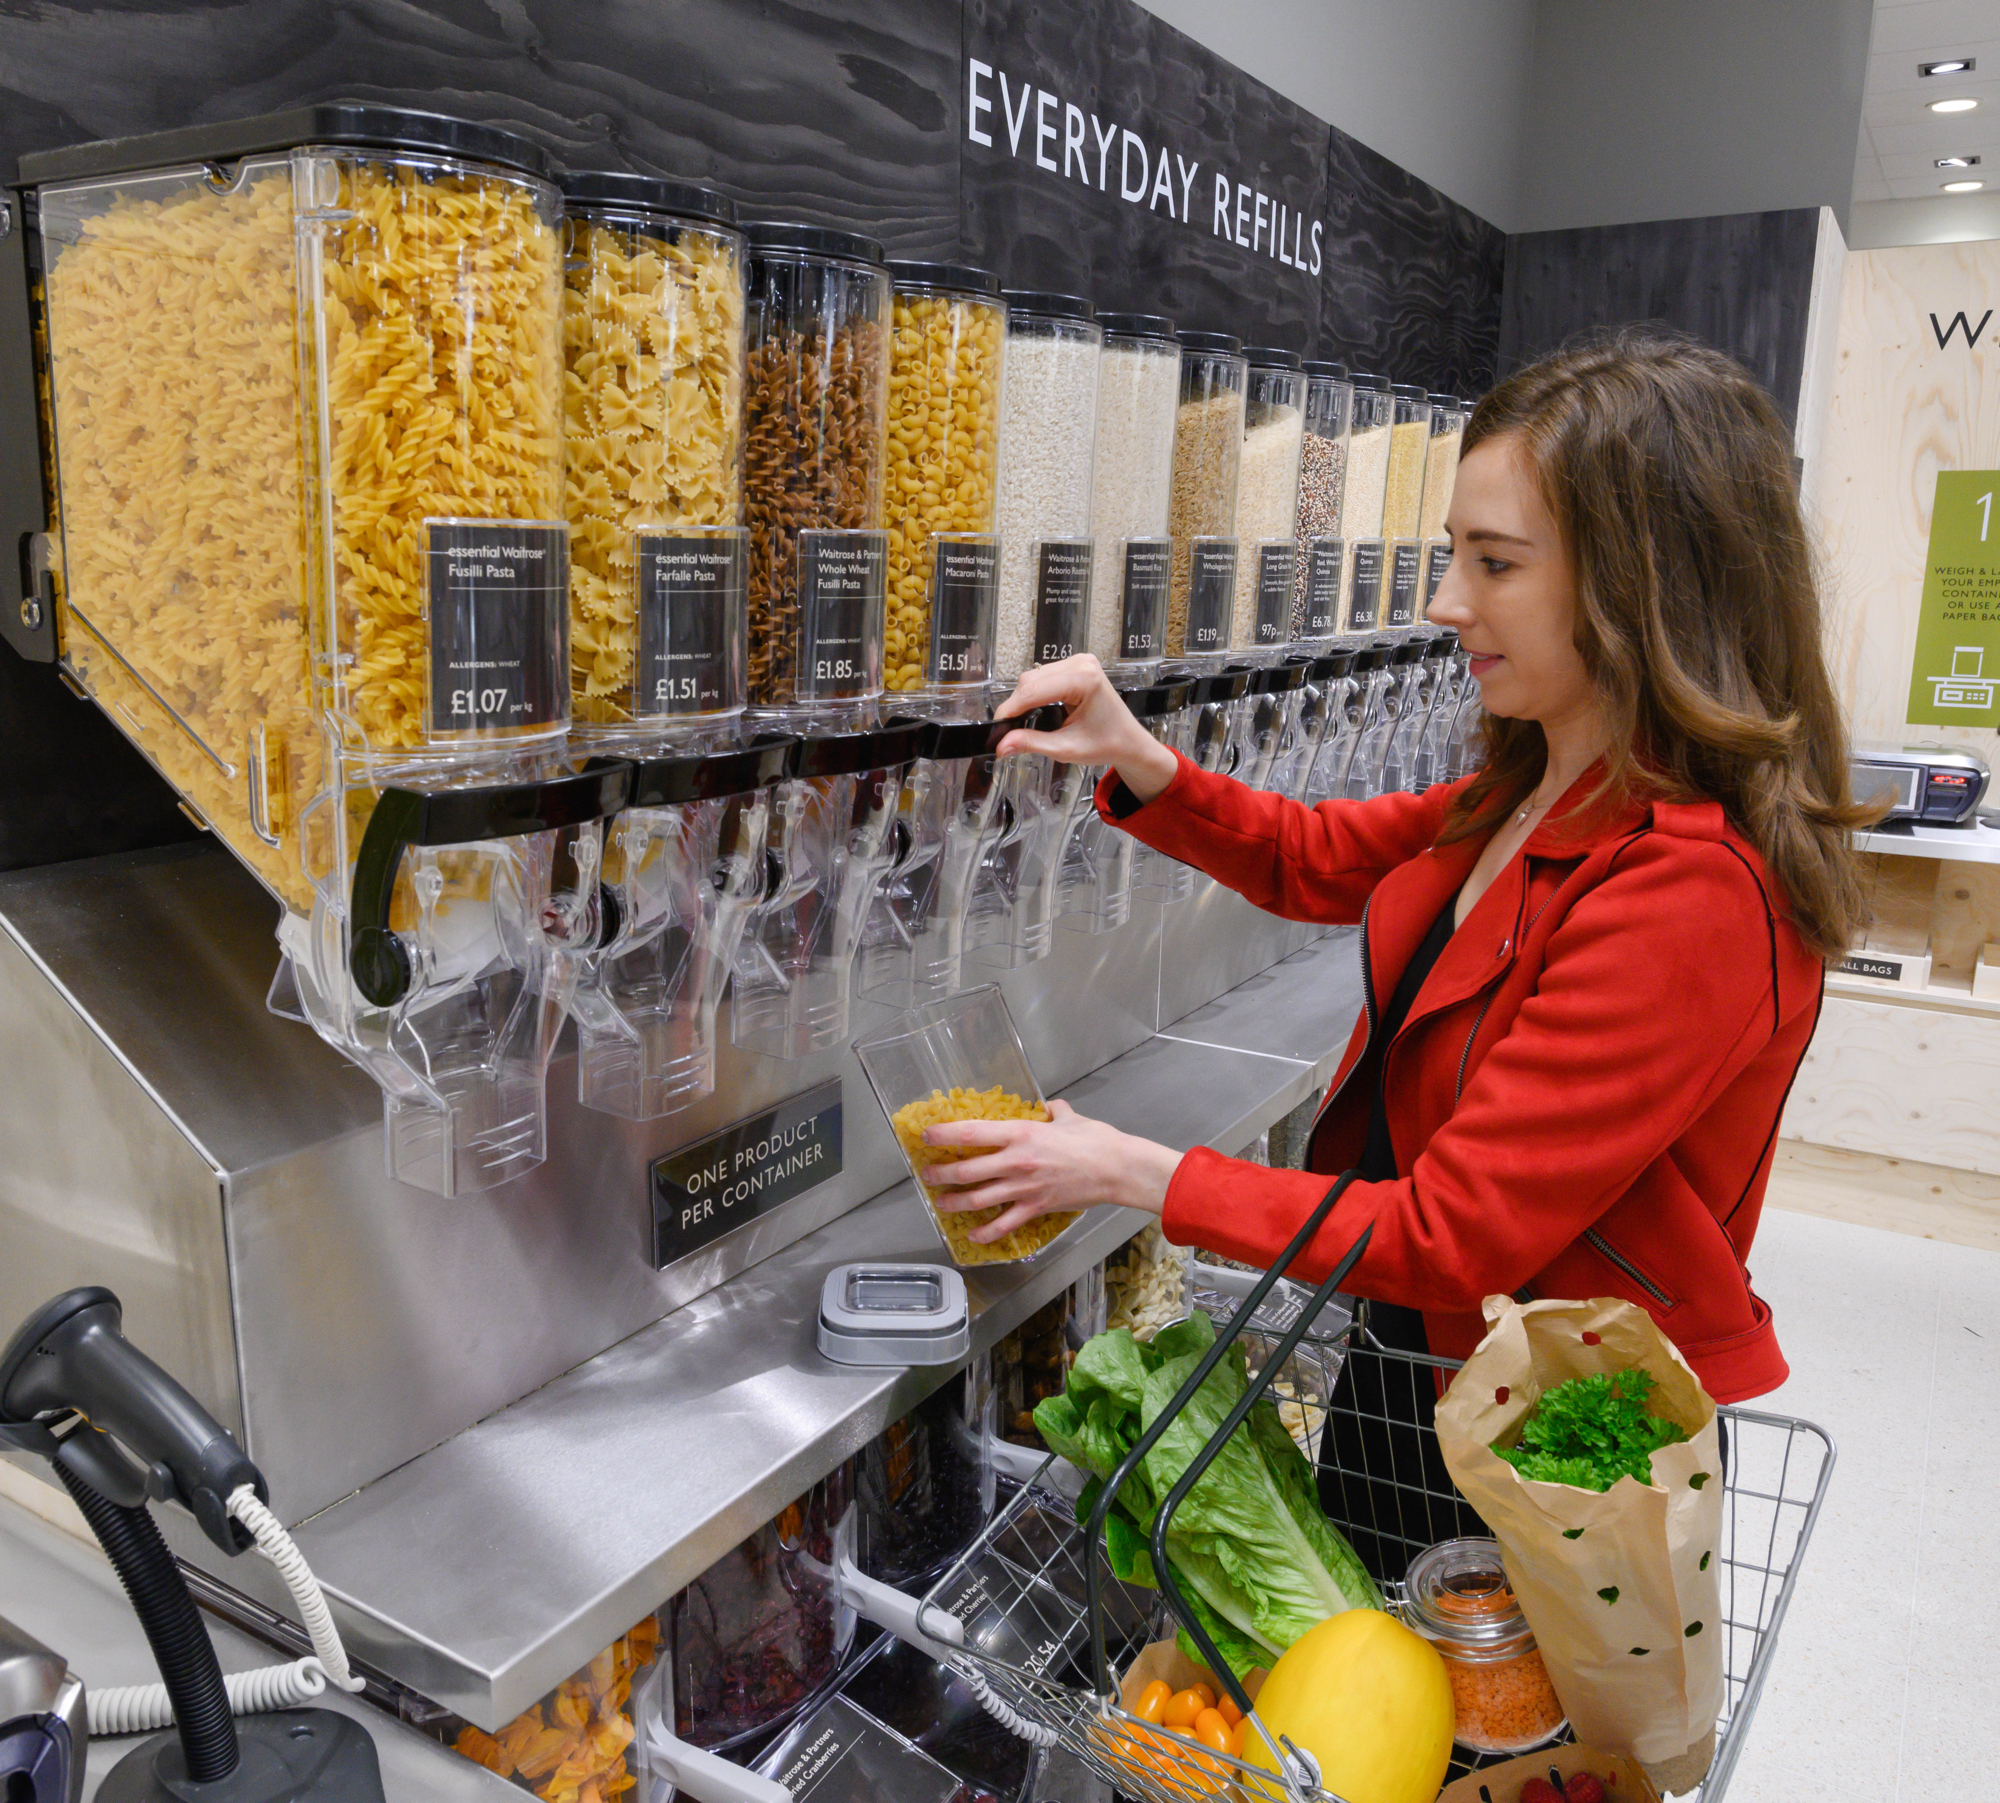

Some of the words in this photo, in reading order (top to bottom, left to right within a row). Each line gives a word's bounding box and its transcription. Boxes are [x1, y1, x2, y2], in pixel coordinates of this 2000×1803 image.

[969, 57, 1199, 224] EVERYDAY
[1213, 172, 1323, 277] REFILLS
[1976, 491, 1993, 542] 1
[448, 545, 500, 559] essential
[655, 553, 697, 565] essential
[818, 548, 855, 559] Waitrose
[856, 550, 862, 559] &
[1049, 553, 1074, 562] Waitrose
[946, 555, 976, 564] essential
[449, 563, 482, 577] Fusilli
[486, 564, 515, 578] Pasta
[655, 569, 692, 581] Farfalle
[694, 570, 716, 581] Pasta
[818, 563, 846, 574] Whole
[848, 564, 870, 574] Wheat
[945, 567, 975, 578] Macaroni
[977, 569, 989, 578] Pasta
[1047, 566, 1070, 575] Arborio
[1935, 566, 1974, 575] WEIGH
[1979, 567, 1986, 575] &
[817, 578, 840, 589] Fusilli
[842, 579, 861, 589] Pasta
[1942, 578, 1973, 587] YOUR
[1942, 590, 2000, 599] CONTAIN
[1948, 601, 1964, 609] OR
[1970, 601, 1990, 610] USE
[1312, 615, 1331, 628] £6.78
[1942, 612, 1976, 621] PAPER
[1197, 628, 1217, 642] £1.19
[1261, 624, 1276, 639] 97p
[1128, 634, 1151, 649] £1.53
[1042, 644, 1073, 660] £2.63
[449, 661, 497, 669] ALLERGENS:
[498, 660, 521, 668] WHEAT
[816, 660, 852, 679] £1.85
[939, 654, 968, 671] £1.51
[655, 677, 696, 700] £1.51
[701, 690, 711, 699] per
[711, 689, 719, 698] kg
[451, 688, 508, 714] £1.07
[510, 703, 523, 713] per
[524, 702, 533, 713] kg
[1836, 961, 1859, 971] ALL
[1863, 964, 1892, 975] BAGS
[686, 1159, 728, 1195] ONE
[735, 1116, 818, 1172] PRODUCT
[681, 1198, 714, 1230] PER
[722, 1143, 823, 1208] CONTAINER
[965, 1575, 989, 1596] Parters
[961, 1593, 970, 1601] &
[946, 1598, 965, 1616] itrose
[1021, 1640, 1056, 1675] 20.54
[805, 1728, 834, 1756] Partners
[800, 1754, 811, 1762] &
[802, 1742, 840, 1780] Cranberries
